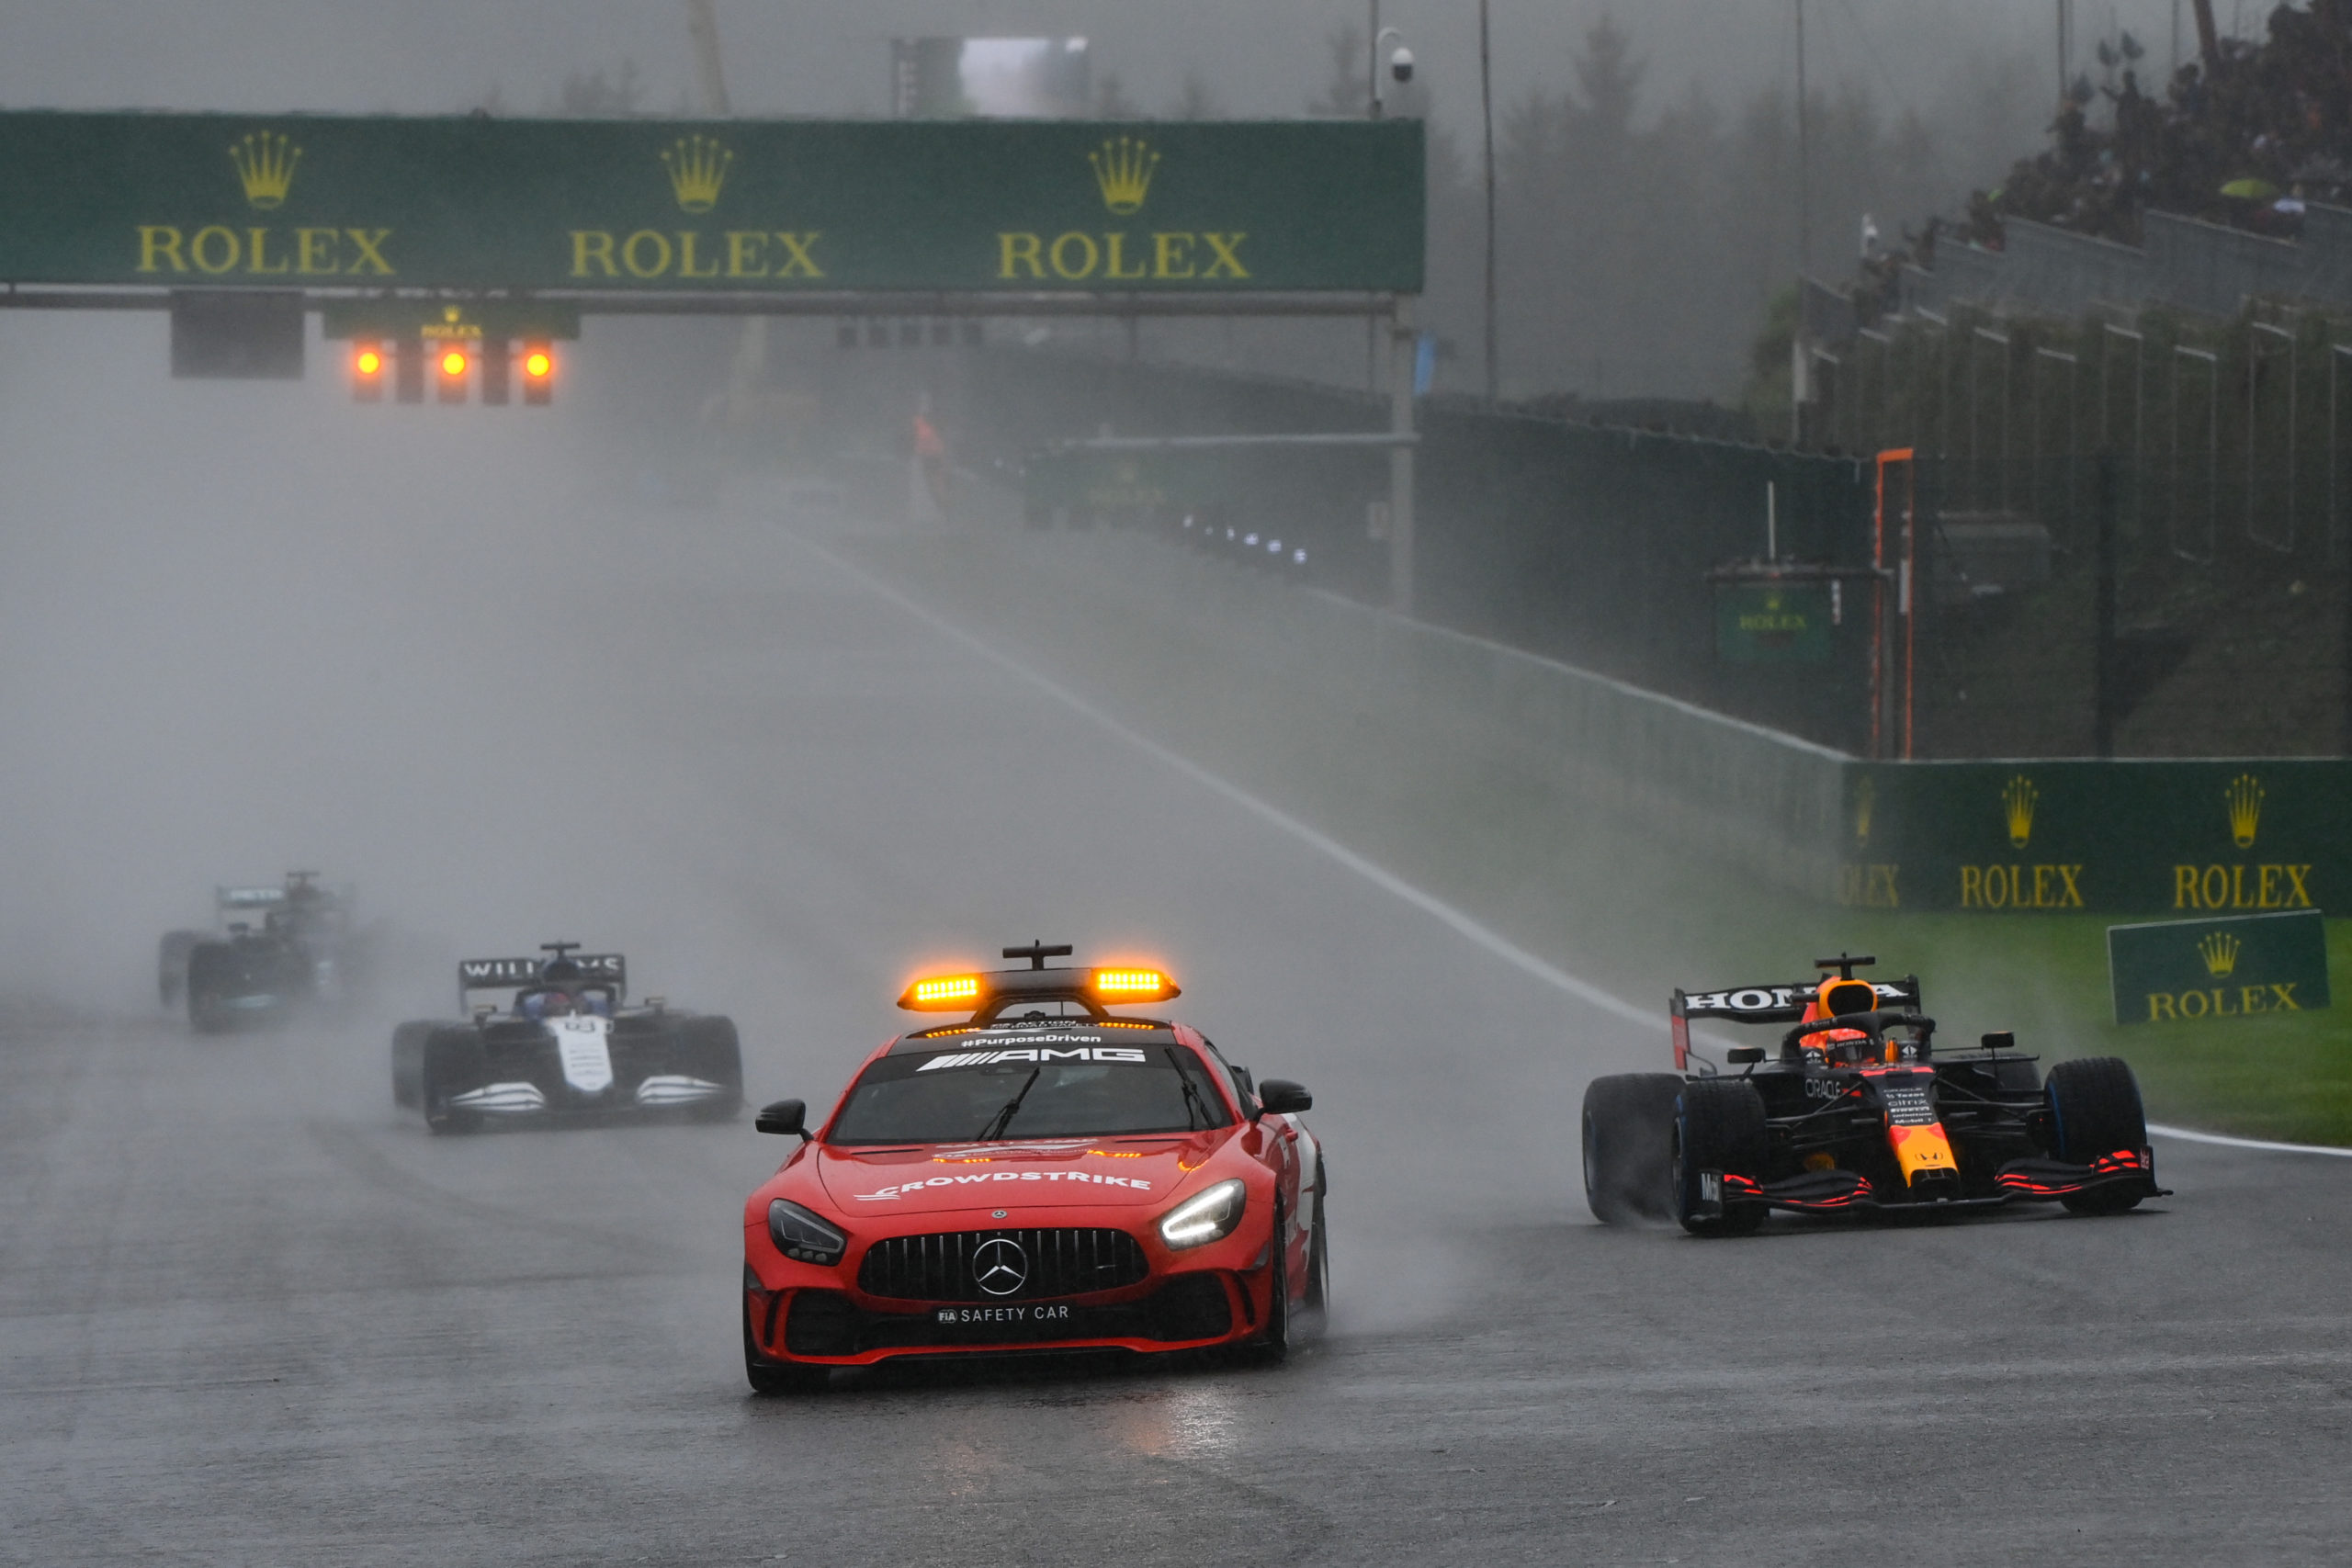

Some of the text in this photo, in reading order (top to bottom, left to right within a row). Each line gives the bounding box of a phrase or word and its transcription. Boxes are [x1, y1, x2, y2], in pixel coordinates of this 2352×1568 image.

[137, 224, 395, 276] ROLEX
[571, 229, 823, 279] ROLEX
[998, 231, 1250, 280] ROLEX
[1839, 863, 1900, 908] OLEX
[1960, 863, 2084, 908] ROLEX
[2174, 863, 2312, 909] ROLEX
[1685, 983, 1908, 1010] HONA
[2146, 983, 2301, 1022] ROLEX
[961, 1034, 1102, 1048] #PurposeDriven
[988, 1048, 1147, 1064] AMG
[875, 1171, 1150, 1195] CROWDSTRIKE
[961, 1308, 1025, 1323] SAFETY
[1035, 1306, 1069, 1320] CAR
